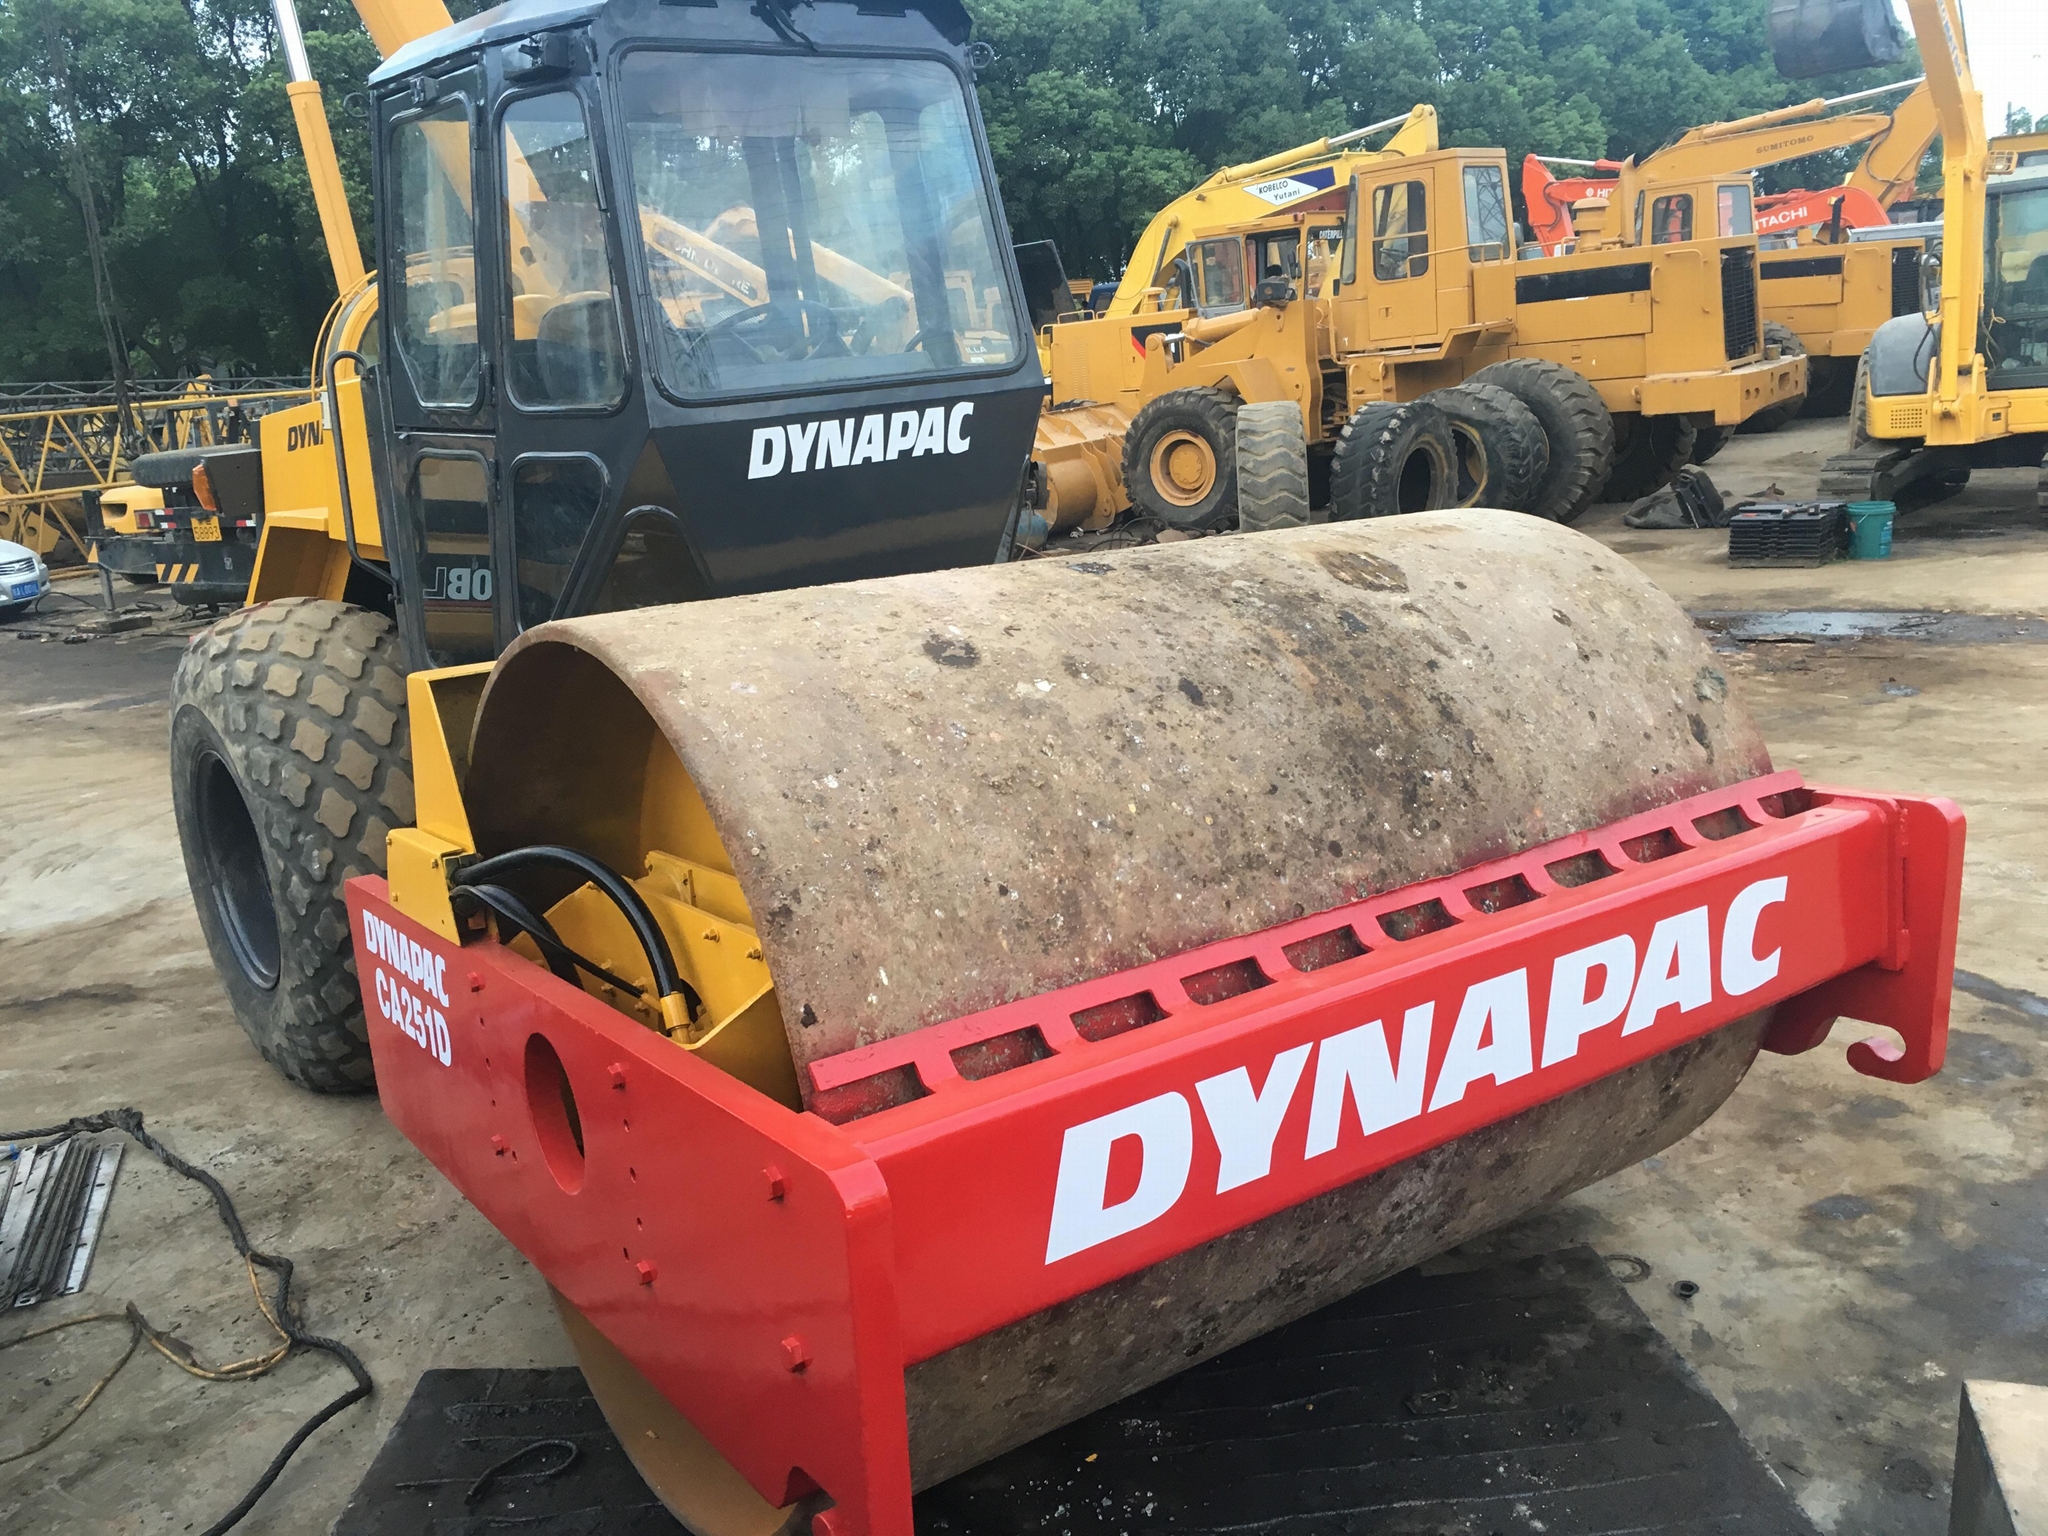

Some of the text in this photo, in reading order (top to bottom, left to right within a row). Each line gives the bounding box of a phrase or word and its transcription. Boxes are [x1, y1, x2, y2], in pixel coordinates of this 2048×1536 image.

[1756, 135, 1814, 154] SUMITOMO
[1258, 180, 1289, 195] KOBELCO
[1273, 188, 1301, 201] Yutani
[287, 419, 324, 452] DYN
[748, 401, 974, 480] DYNAPAC
[363, 908, 450, 1008] DYNAPAC
[375, 967, 452, 1067] CA251D
[1045, 876, 1788, 1266] DYNAPAC
